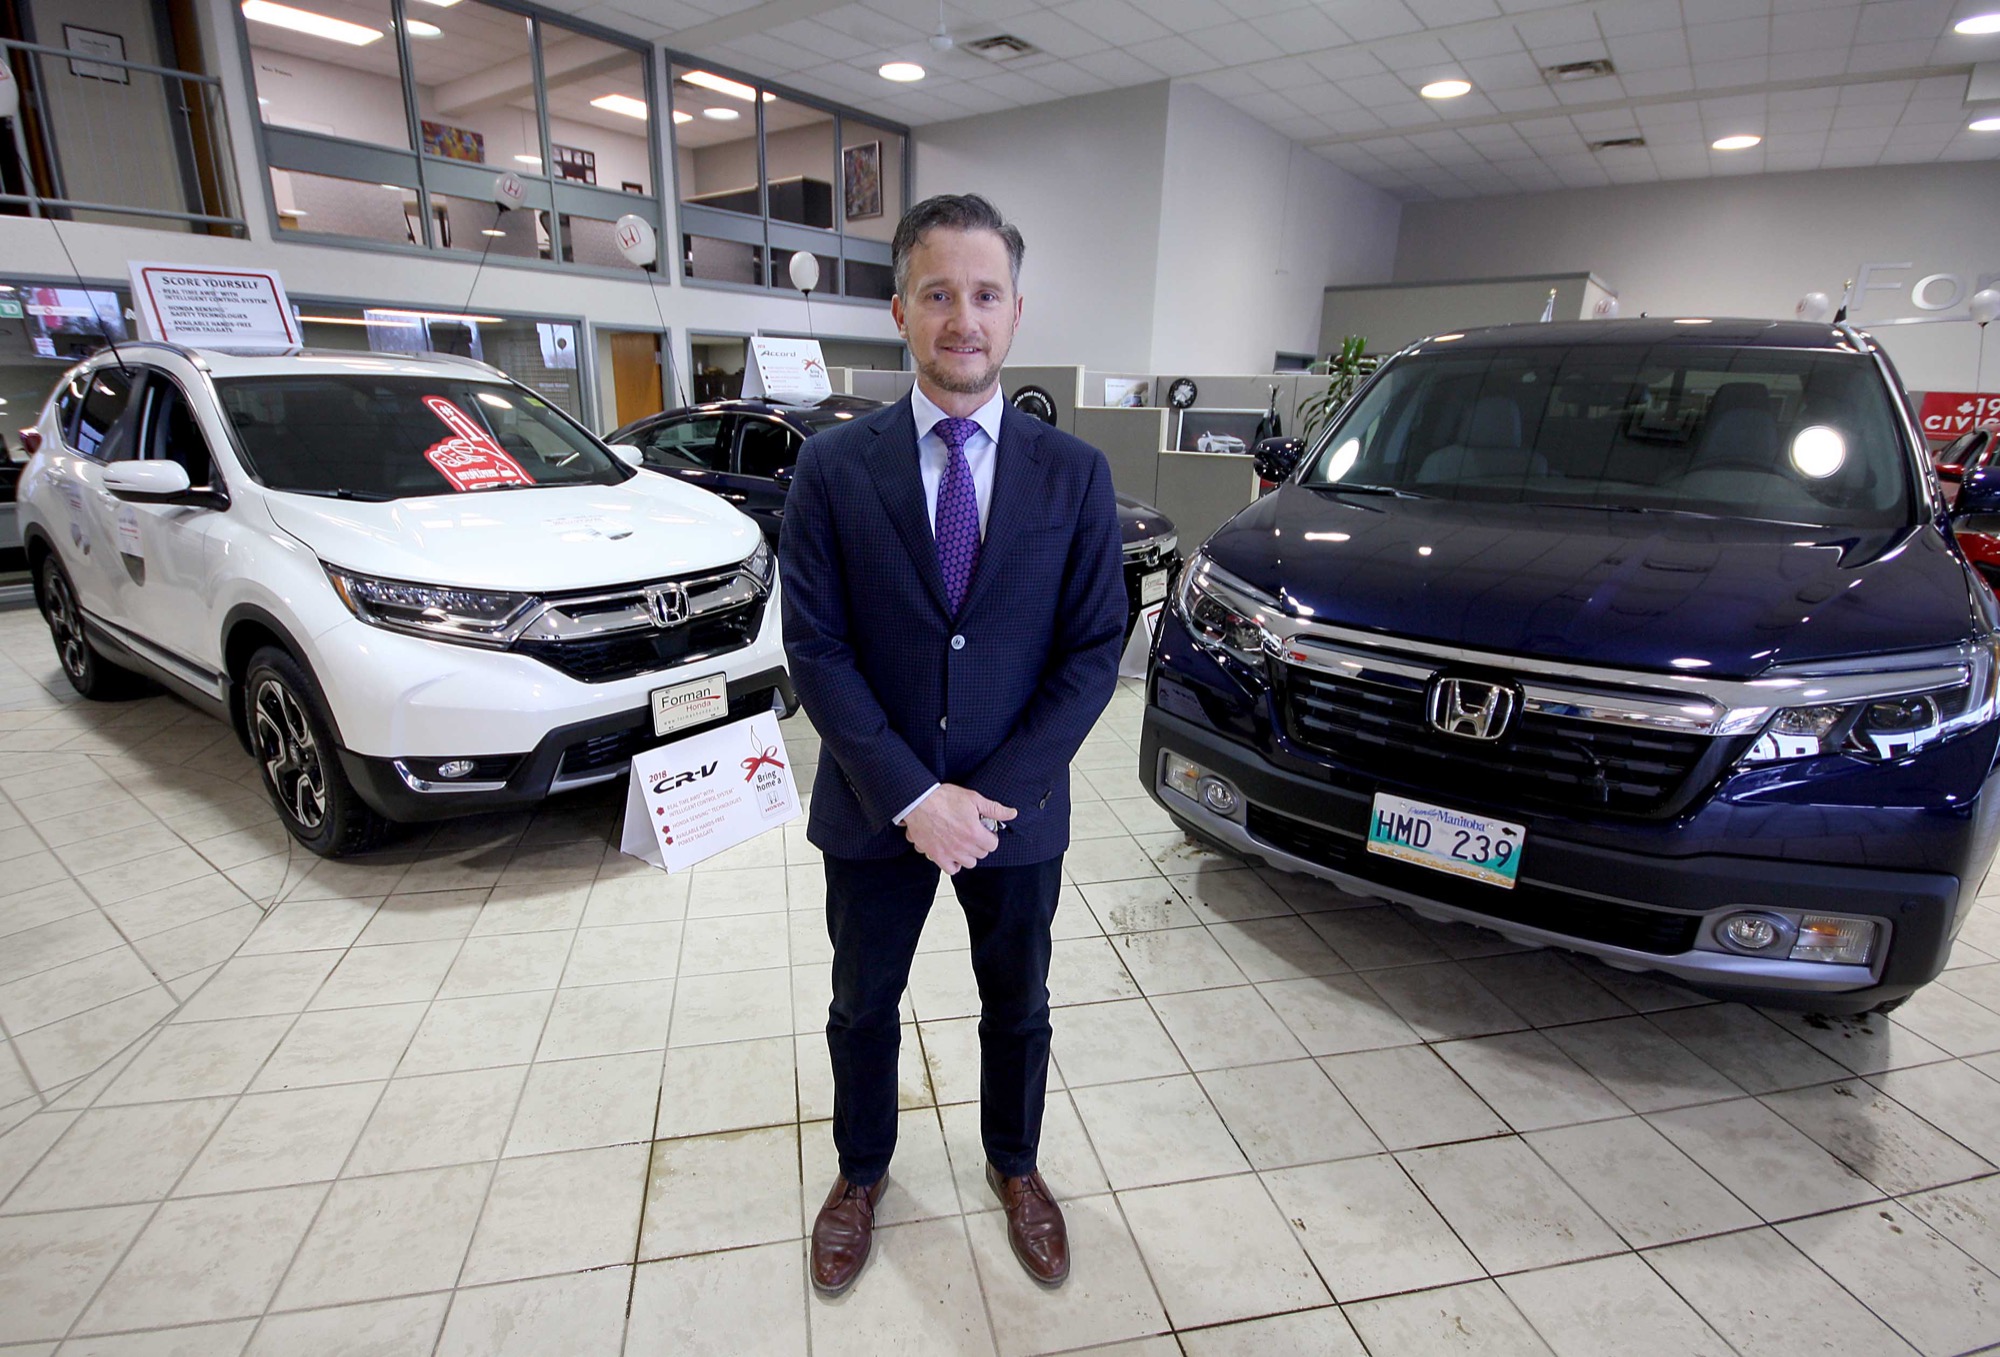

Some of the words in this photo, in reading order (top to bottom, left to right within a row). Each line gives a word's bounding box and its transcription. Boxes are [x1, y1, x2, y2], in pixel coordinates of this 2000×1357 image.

[162, 276, 201, 287] SCORE
[202, 279, 259, 289] YOURSELF
[439, 405, 484, 441] #1
[661, 687, 711, 708] Forman
[686, 700, 711, 712] Honda
[648, 770, 667, 783] 2018
[653, 760, 718, 794] CR-V
[756, 780, 775, 792] home
[757, 770, 777, 783] Bring
[666, 803, 678, 811] REAL
[669, 802, 697, 817] INTELLIGENT
[697, 795, 716, 807] CONTROL
[672, 818, 689, 829] HONDA
[711, 796, 742, 813] TECHNOLOGIES
[764, 801, 785, 812] HONDA
[676, 826, 699, 839] AVAILABLE
[699, 815, 725, 829] HANDS-FREE
[1437, 810, 1486, 832] Manitoba
[677, 835, 695, 847] POWER
[694, 828, 714, 839] TAILGATE
[1376, 809, 1432, 848] HMD
[1451, 830, 1513, 868] 239
